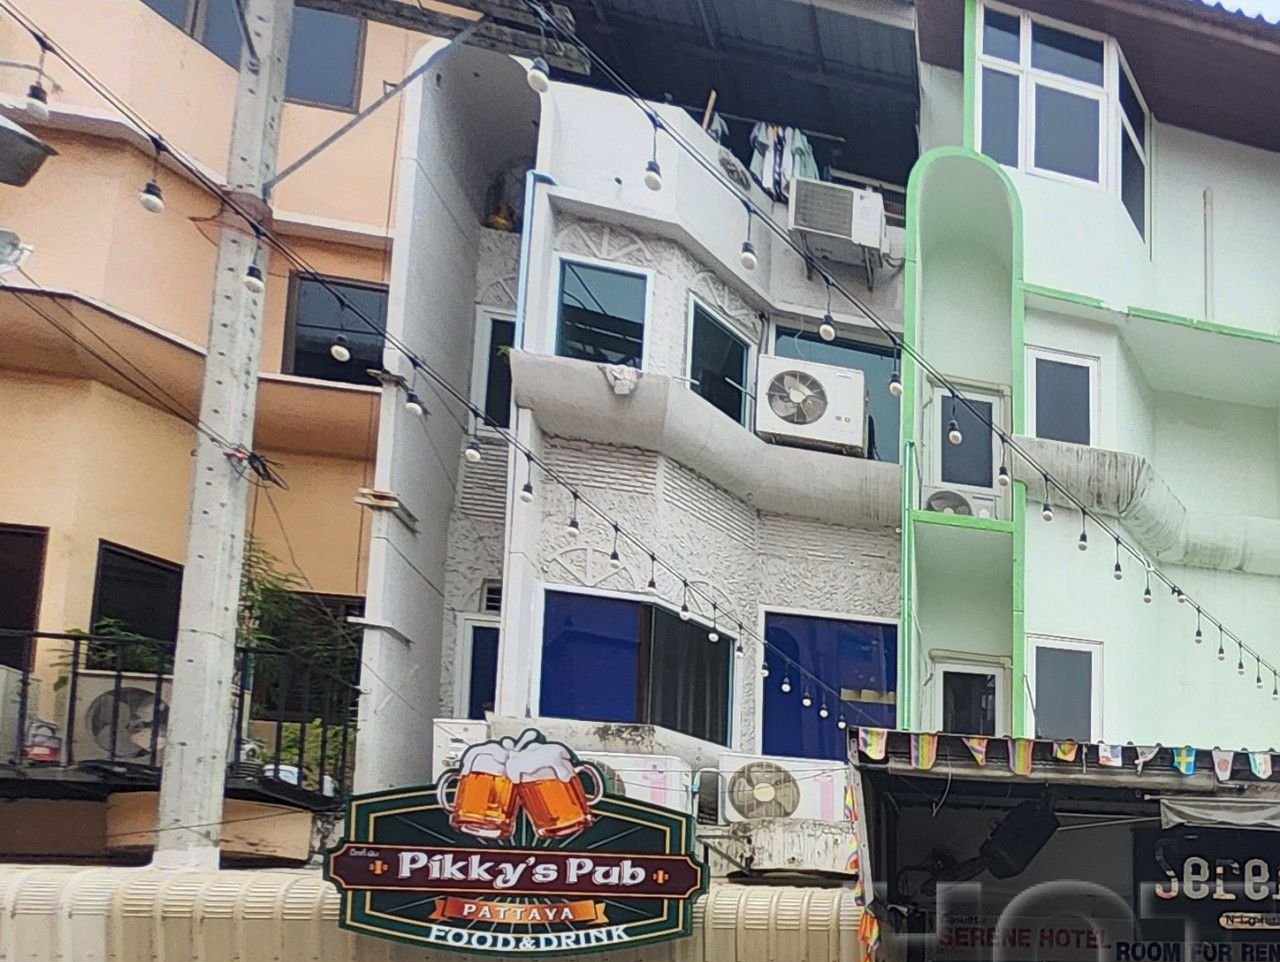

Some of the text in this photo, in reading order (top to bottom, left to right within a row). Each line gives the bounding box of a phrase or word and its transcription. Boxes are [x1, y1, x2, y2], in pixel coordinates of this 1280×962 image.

[397, 851, 646, 889] Pikky's Pub
[462, 903, 576, 921] PATTAYA
[428, 924, 630, 952] FOOD&DRINK
[939, 927, 1112, 949] SERENE HOTEL
[1116, 941, 1180, 962] ROOM
[1192, 942, 1232, 962] FOR
